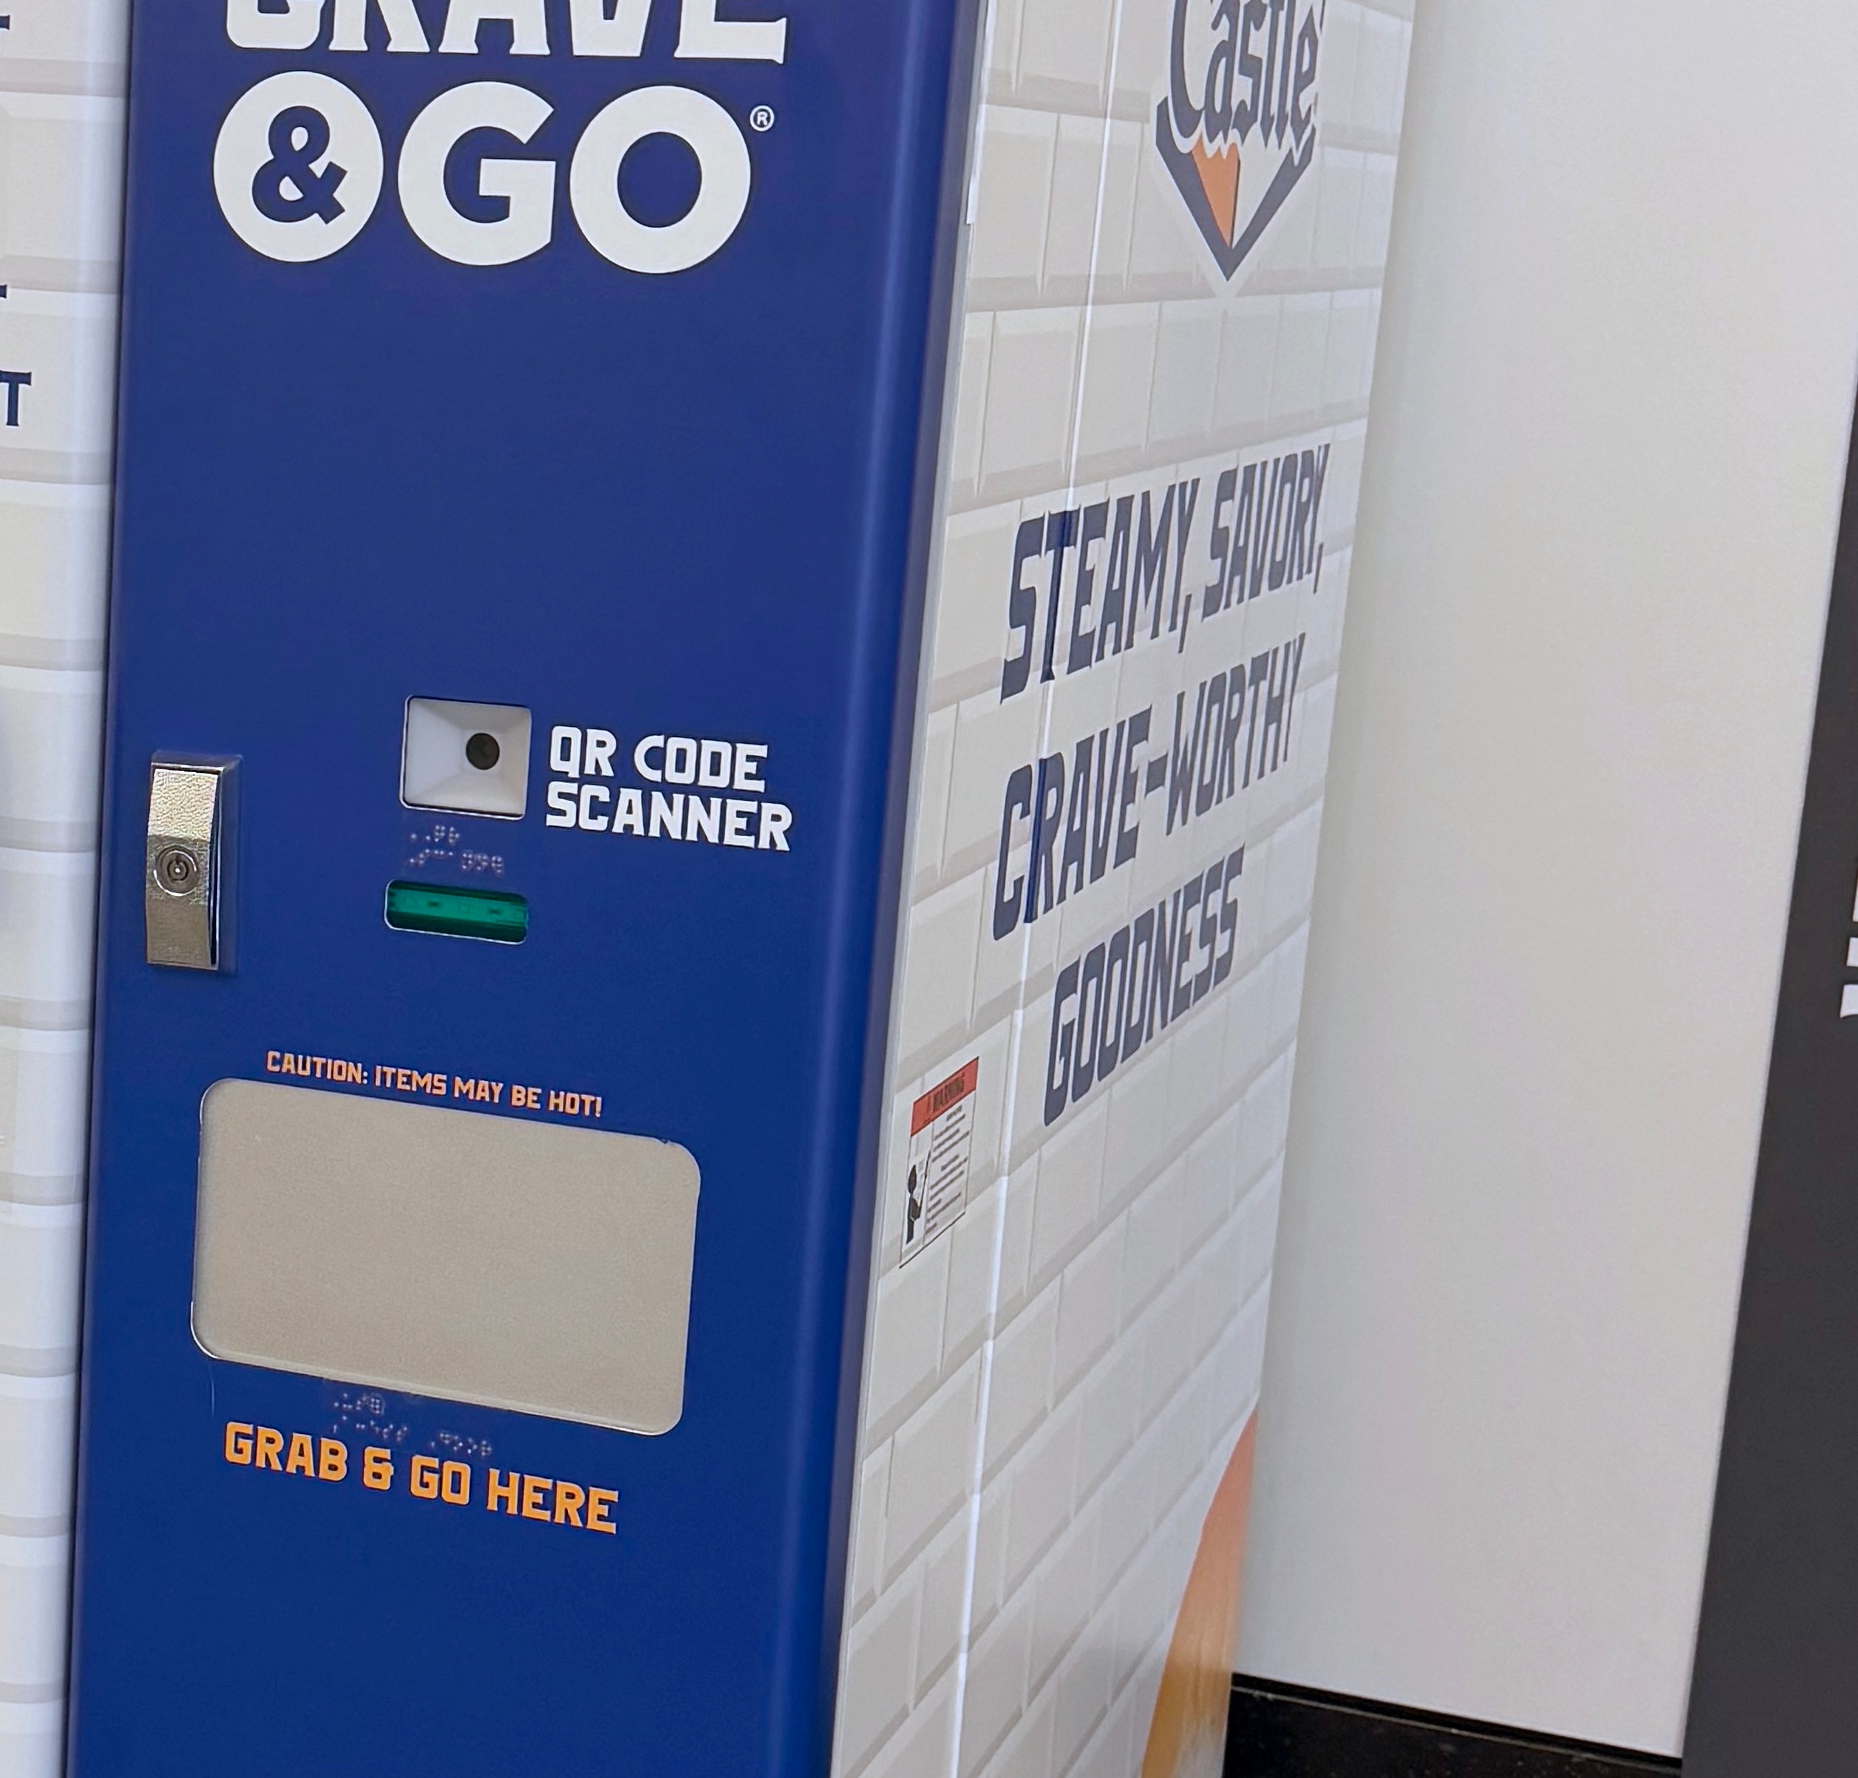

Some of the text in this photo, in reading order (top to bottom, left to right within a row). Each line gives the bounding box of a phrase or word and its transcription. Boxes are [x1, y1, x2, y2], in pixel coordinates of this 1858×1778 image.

[1000, 443, 1330, 705] STEAMY, SAVORY,
[550, 725, 768, 792] QR CODE
[546, 782, 792, 851] SCANNER
[1044, 844, 1245, 1127] GOODNESS
[266, 1050, 602, 1118] CAUTION: ITEMS MAY BE HOT!
[225, 1421, 348, 1482] GRAB
[363, 1446, 394, 1490] &
[411, 1454, 471, 1505] GO
[487, 1468, 619, 1534] HERE
